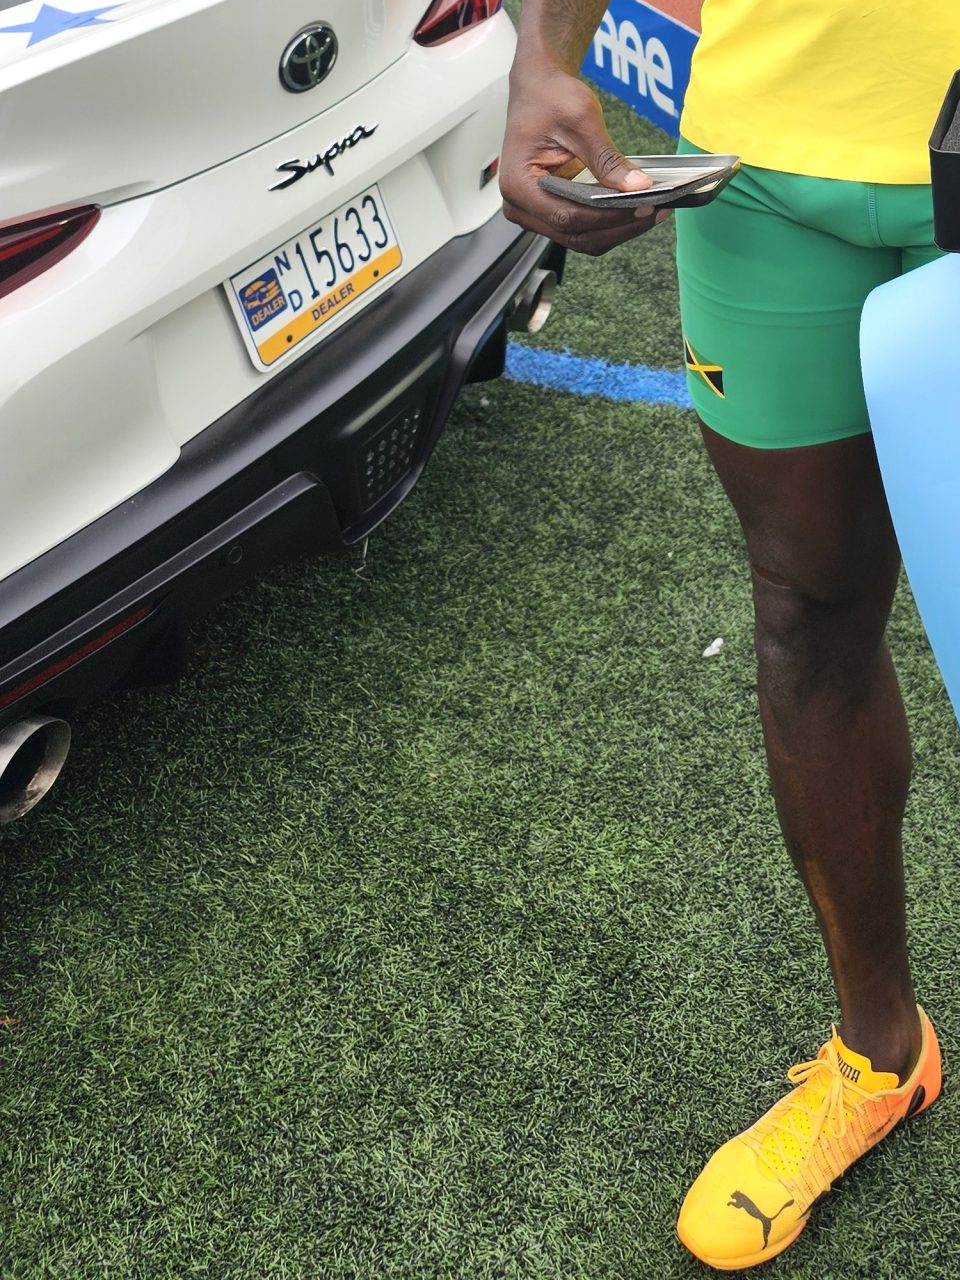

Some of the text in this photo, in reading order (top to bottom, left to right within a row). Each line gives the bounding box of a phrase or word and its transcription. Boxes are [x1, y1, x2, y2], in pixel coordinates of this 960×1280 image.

[267, 121, 380, 192] Supra
[295, 194, 389, 300] 15633
[251, 296, 286, 326] DEALER
[311, 282, 355, 322] DEALER
